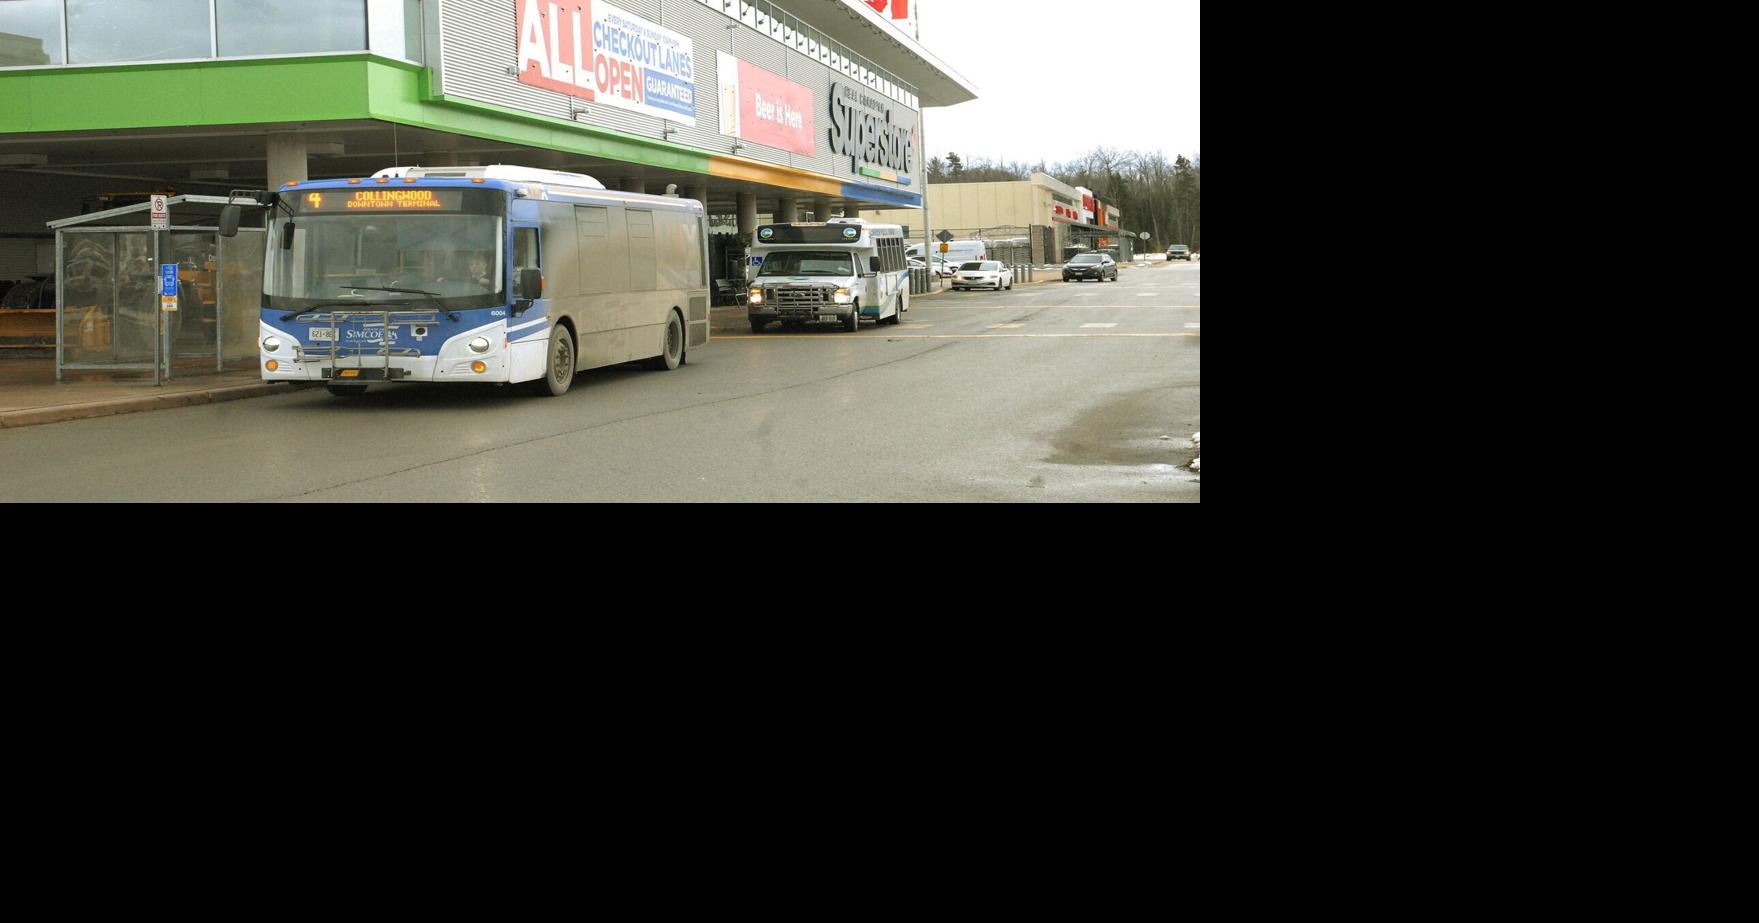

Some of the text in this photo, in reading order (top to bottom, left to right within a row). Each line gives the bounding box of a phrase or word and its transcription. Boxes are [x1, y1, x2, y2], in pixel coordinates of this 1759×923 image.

[518, 0, 594, 91] ALL
[593, 20, 692, 79] CHECKOUT LANES
[594, 53, 643, 103] OPEN
[646, 76, 693, 104] GUARANTEED
[755, 92, 803, 130] Beer is Here
[829, 81, 913, 174] Superstore
[308, 192, 321, 208] 4
[347, 199, 441, 208] DOWNTOWN TERMINAL
[355, 190, 432, 201] COLLINGWOOD
